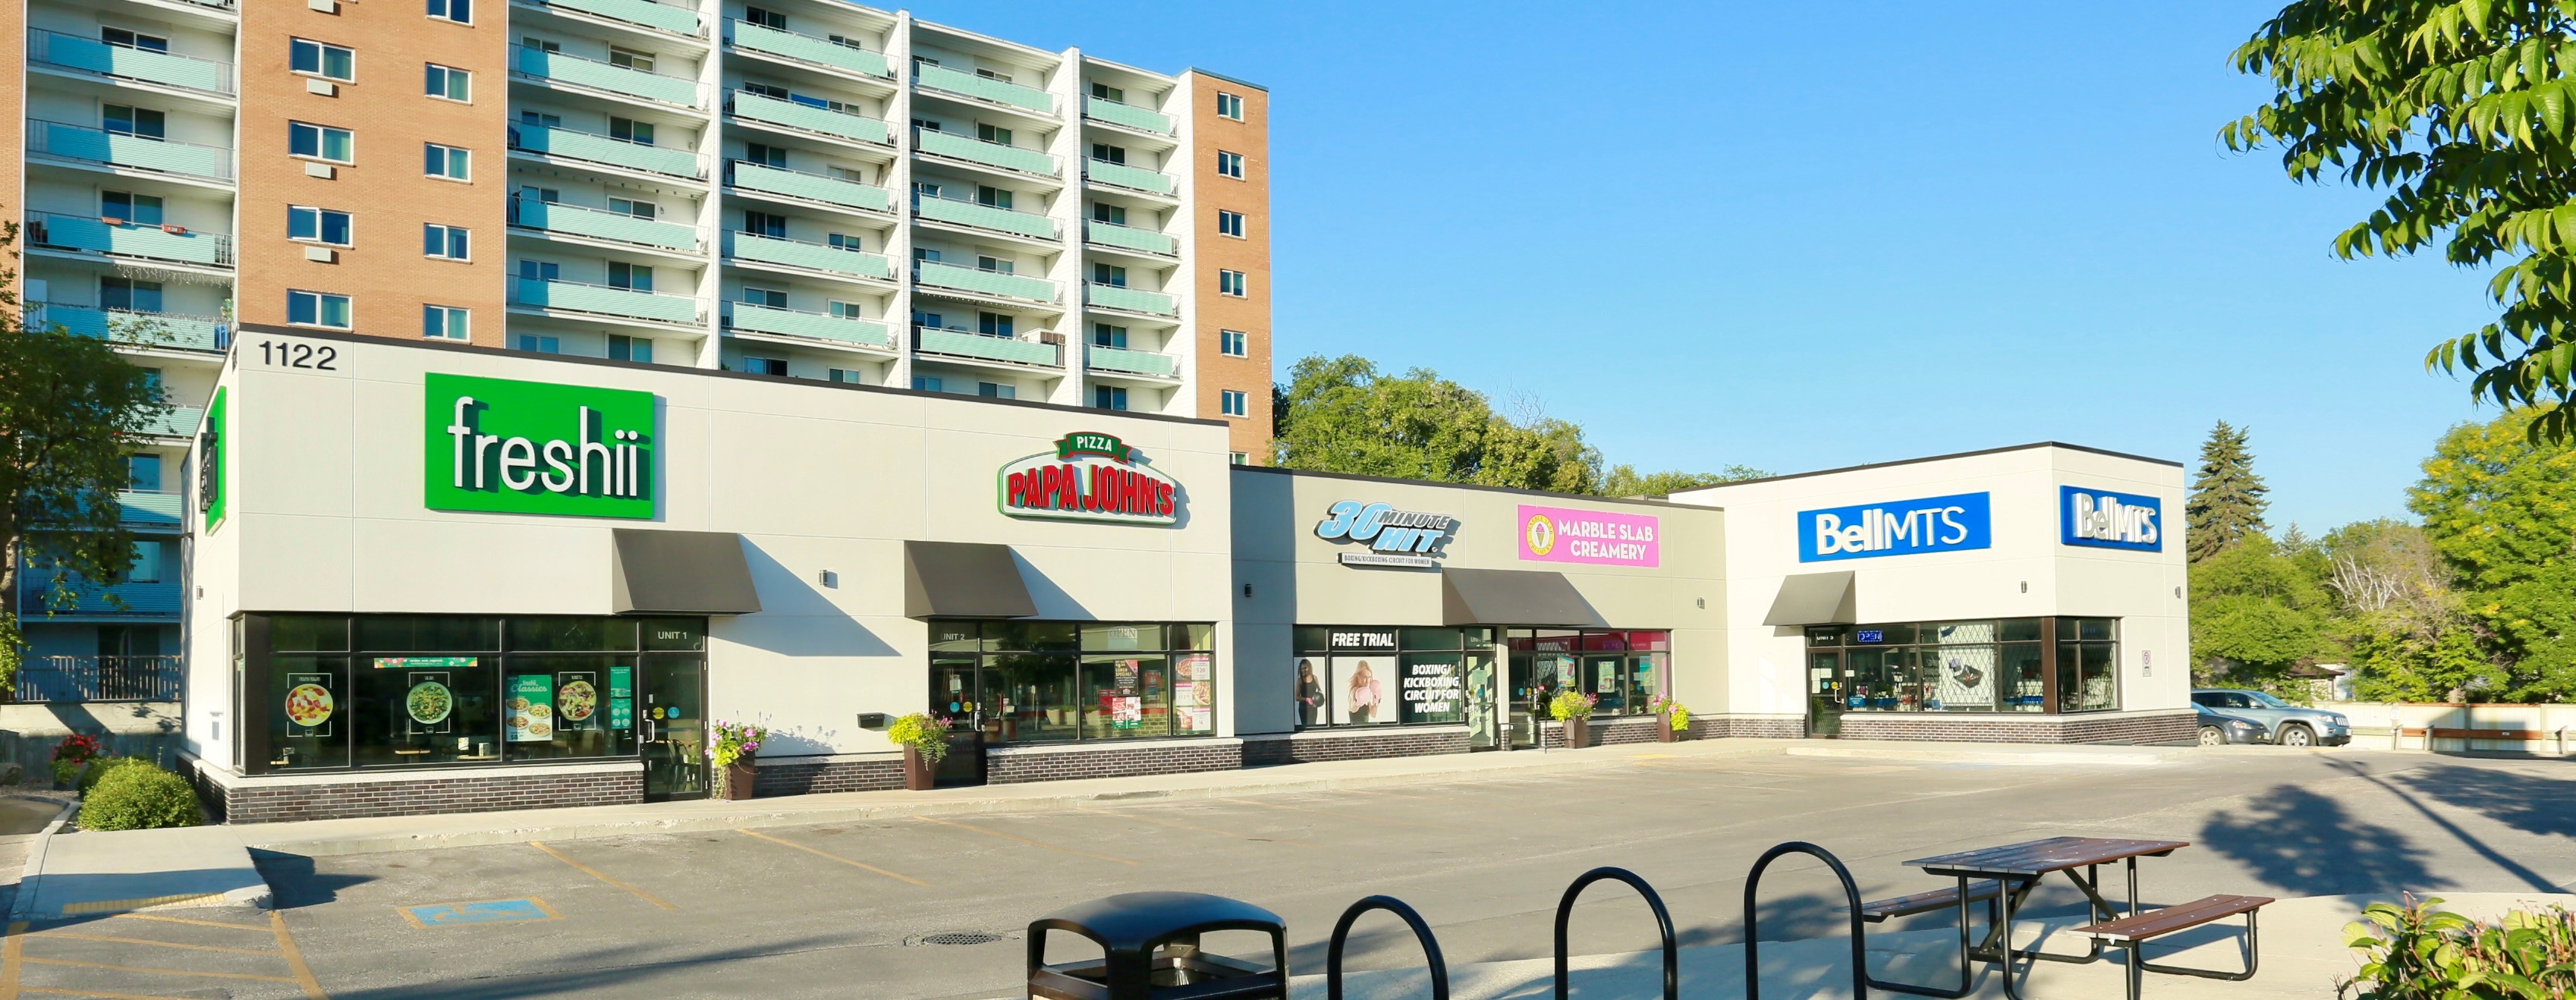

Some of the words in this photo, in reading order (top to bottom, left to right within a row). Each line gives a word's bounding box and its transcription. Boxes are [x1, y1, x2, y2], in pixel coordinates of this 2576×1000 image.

[259, 341, 337, 371] 1122
[447, 395, 638, 497] freshii
[1076, 436, 1112, 452] PIZZA
[1006, 464, 1079, 509] PAPA
[1080, 464, 1175, 516] JOHN'S
[1315, 499, 1393, 540] 30
[1377, 510, 1452, 530] MINUTE
[1558, 519, 1616, 539] MARBLE
[1619, 524, 1654, 542] SLAB
[1372, 526, 1445, 553] HIT
[1570, 540, 1647, 561] CREAMERY
[1344, 554, 1389, 564] BOXING/KICKBOXING
[658, 631, 681, 640] UNIT
[682, 631, 687, 640] 1
[1109, 627, 1136, 638] OPEN
[1332, 633, 1363, 647] FREE
[1362, 633, 1395, 646] TRIAL
[1412, 664, 1452, 675] BOXING/
[511, 684, 548, 693] Classics
[1403, 676, 1460, 688] KICKBOXING
[1404, 689, 1442, 701] CIRCUIT
[1441, 688, 1460, 700] FOR
[1414, 702, 1451, 713] WOMEN
